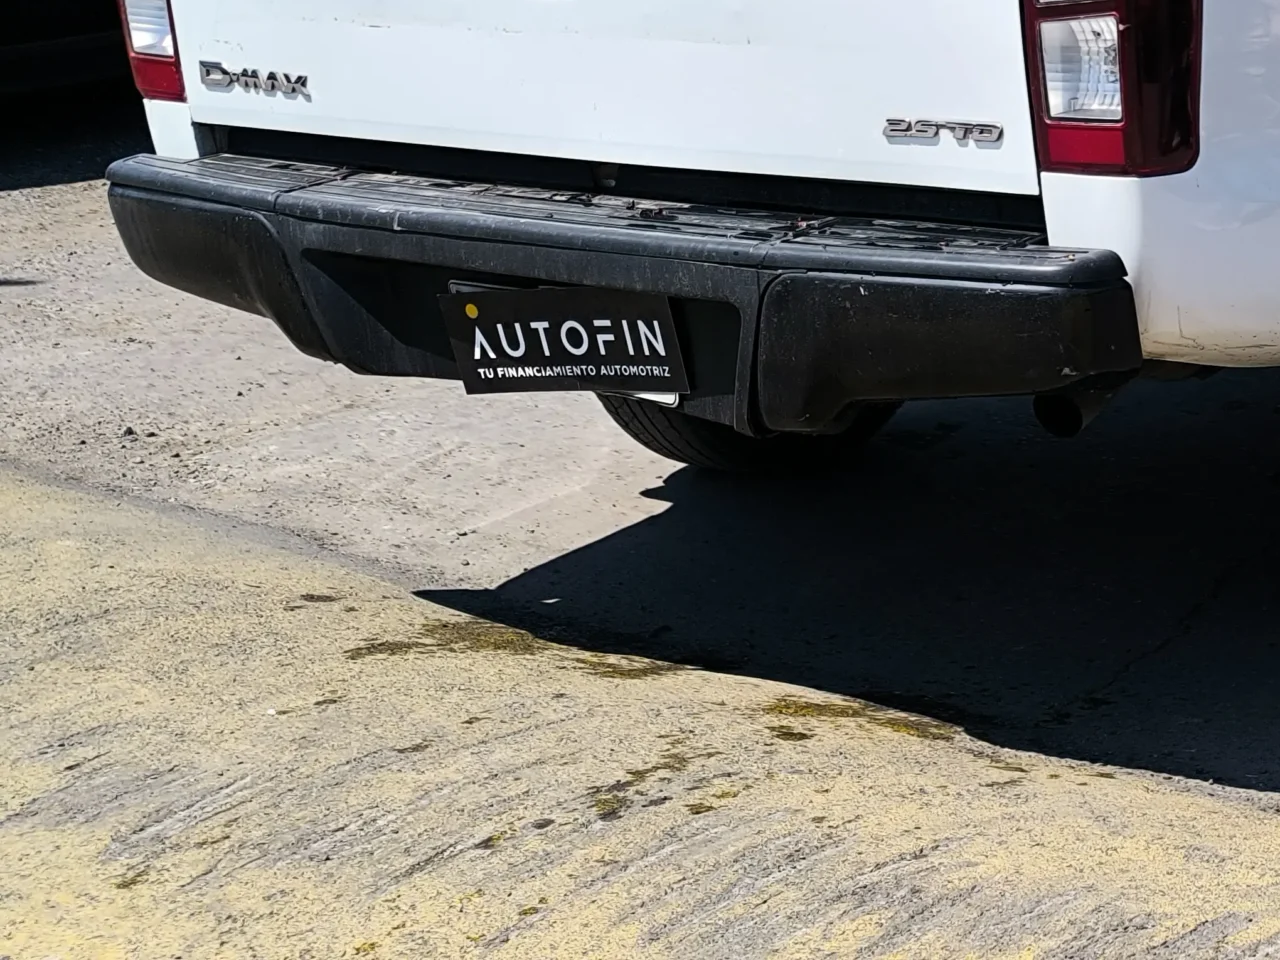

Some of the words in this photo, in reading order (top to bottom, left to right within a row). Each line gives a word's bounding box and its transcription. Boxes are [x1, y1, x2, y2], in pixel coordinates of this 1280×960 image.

[473, 318, 667, 361] AUTOFIN
[477, 367, 495, 380] TU
[497, 364, 597, 379] FINANCIAMIENTO
[600, 365, 671, 378] AUTOMOTRIZ
